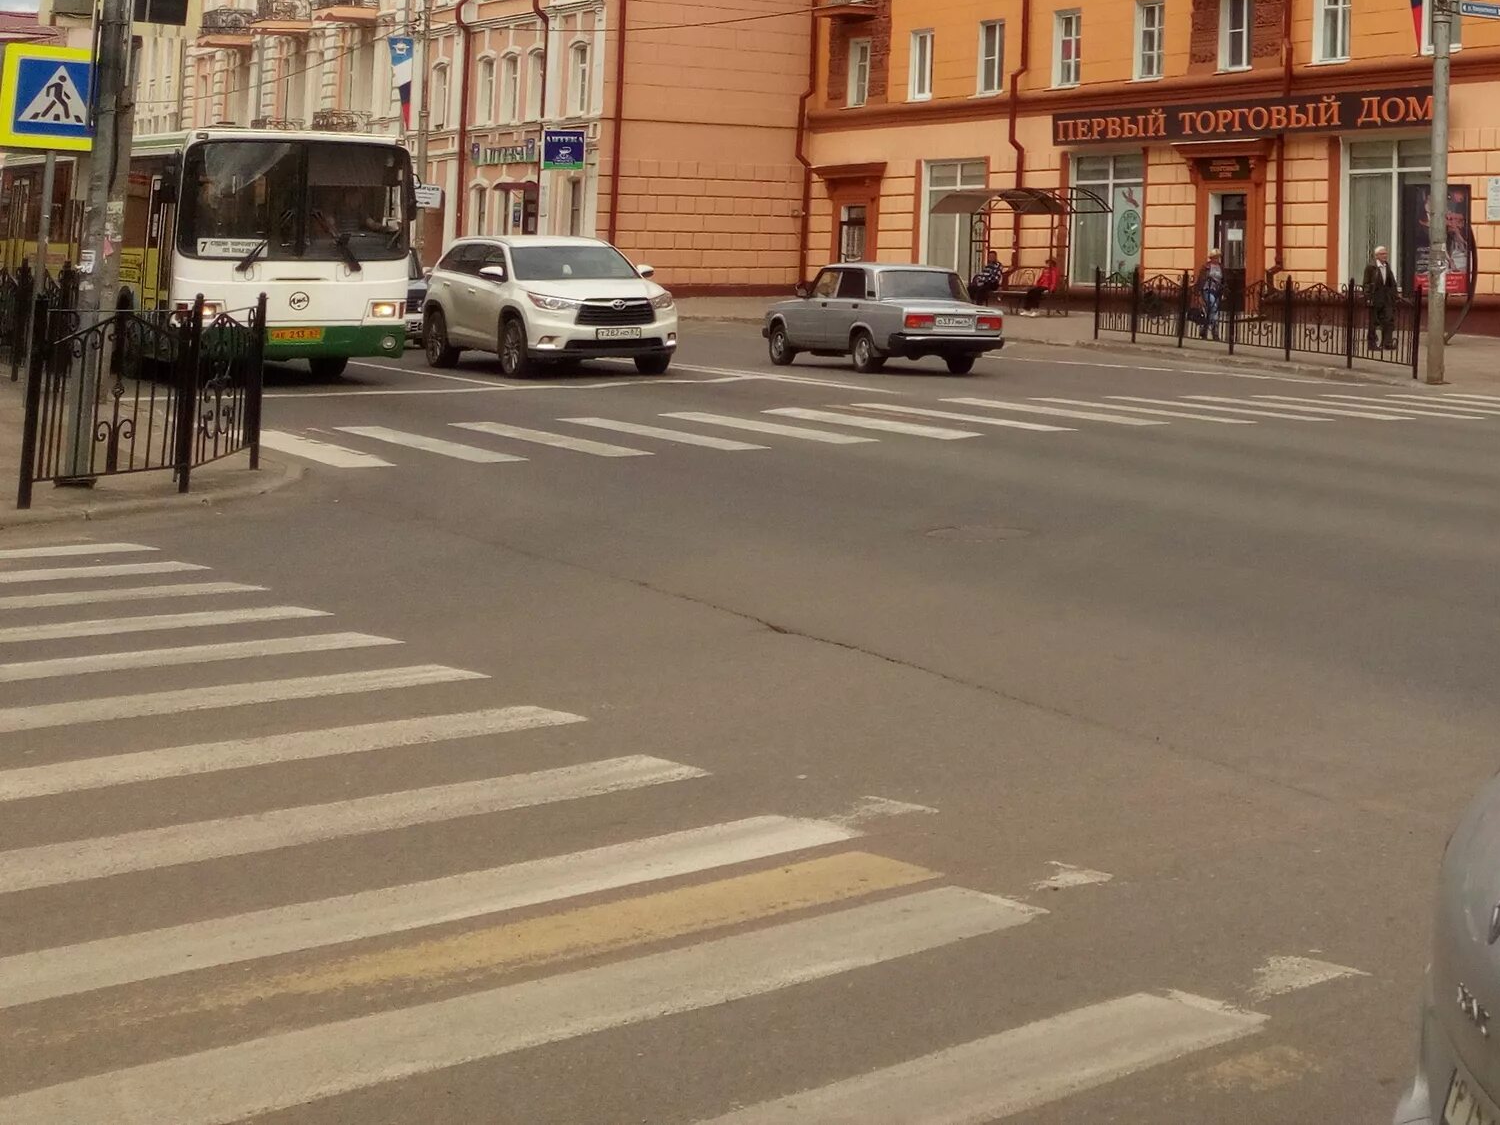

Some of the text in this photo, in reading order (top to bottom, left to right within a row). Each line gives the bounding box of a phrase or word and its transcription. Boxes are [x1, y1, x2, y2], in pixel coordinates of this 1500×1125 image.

[1056, 94, 1434, 142] ПЕРВЫЙ ТОРГОВЫЙ ДОМ
[200, 241, 208, 253] 7
